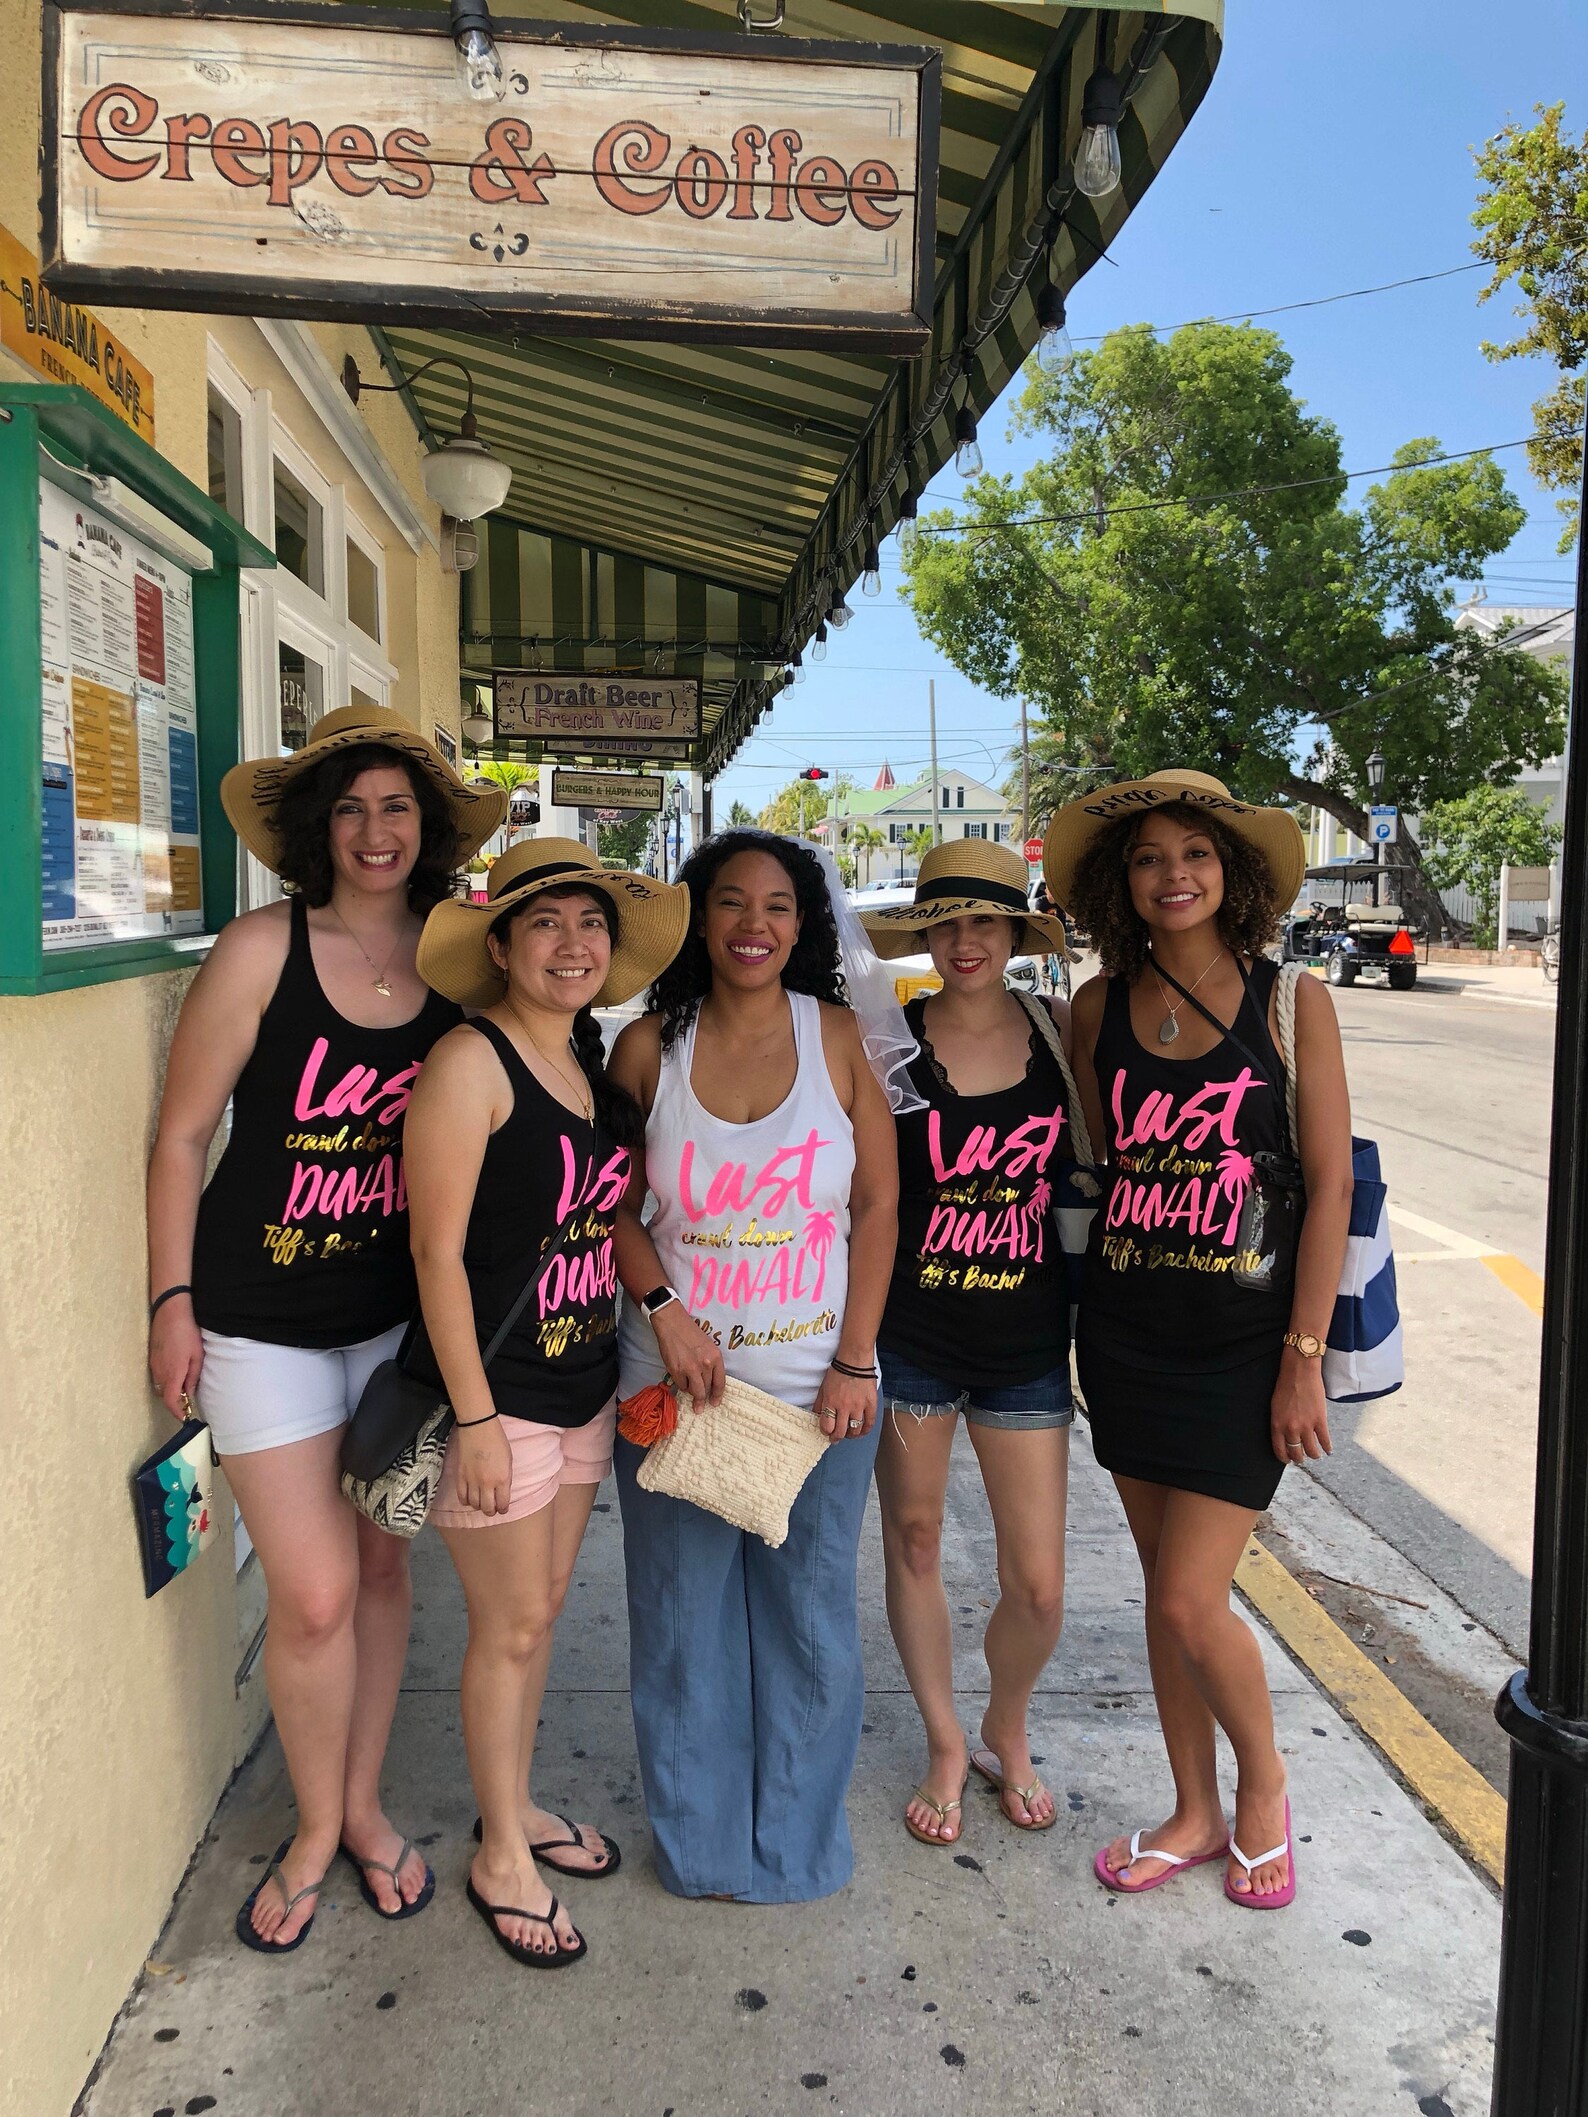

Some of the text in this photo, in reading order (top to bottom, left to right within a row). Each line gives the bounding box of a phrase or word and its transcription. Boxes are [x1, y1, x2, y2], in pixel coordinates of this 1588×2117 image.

[76, 82, 903, 232] Crepes & Coffee
[21, 276, 101, 376] BANANA
[104, 340, 141, 428] CAFE
[534, 682, 663, 708] Draft Beer
[534, 707, 664, 731] French Wine
[556, 783, 594, 796] BURGERS
[604, 785, 633, 798] HAPPY
[634, 786, 660, 799] HOUR
[294, 1036, 424, 1126] Las
[1111, 1066, 1269, 1152] Last
[285, 1125, 349, 1153] crawl
[928, 1104, 1068, 1184] Last
[1159, 1144, 1213, 1176] down
[678, 1127, 838, 1225] Last
[681, 1217, 798, 1249] crawl down
[920, 1203, 1036, 1260] DUVAL
[1105, 1176, 1224, 1237] DUVAL
[687, 1246, 812, 1315] DUVAL
[1102, 1235, 1143, 1273] Tiff's
[727, 1307, 838, 1351] Bachelorette
